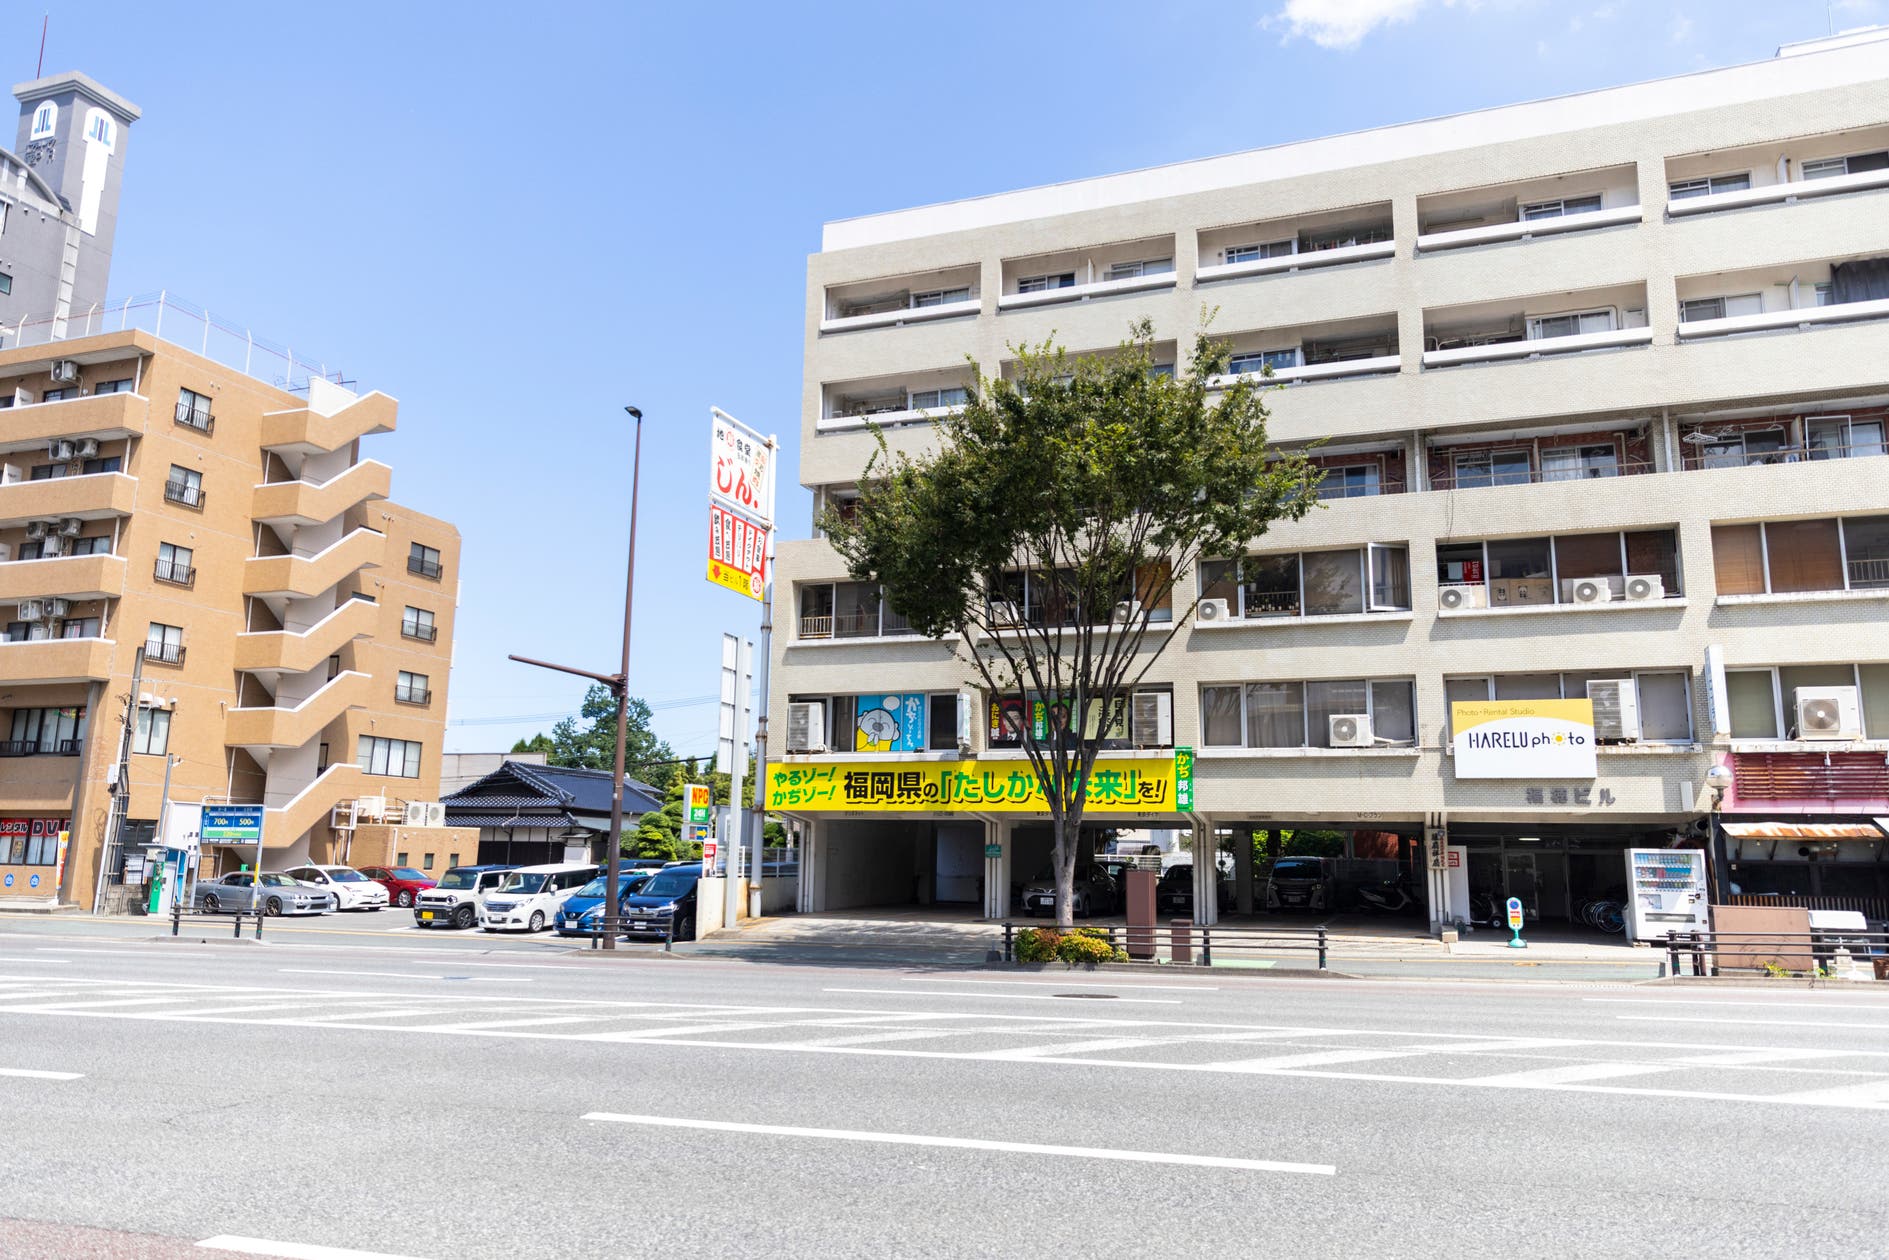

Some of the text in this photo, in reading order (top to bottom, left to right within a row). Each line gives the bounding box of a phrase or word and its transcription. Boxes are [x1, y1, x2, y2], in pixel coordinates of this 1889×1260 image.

[1510, 707, 1535, 715] Studio
[1468, 732, 1528, 749] HARELU
[692, 787, 708, 804] NPC
